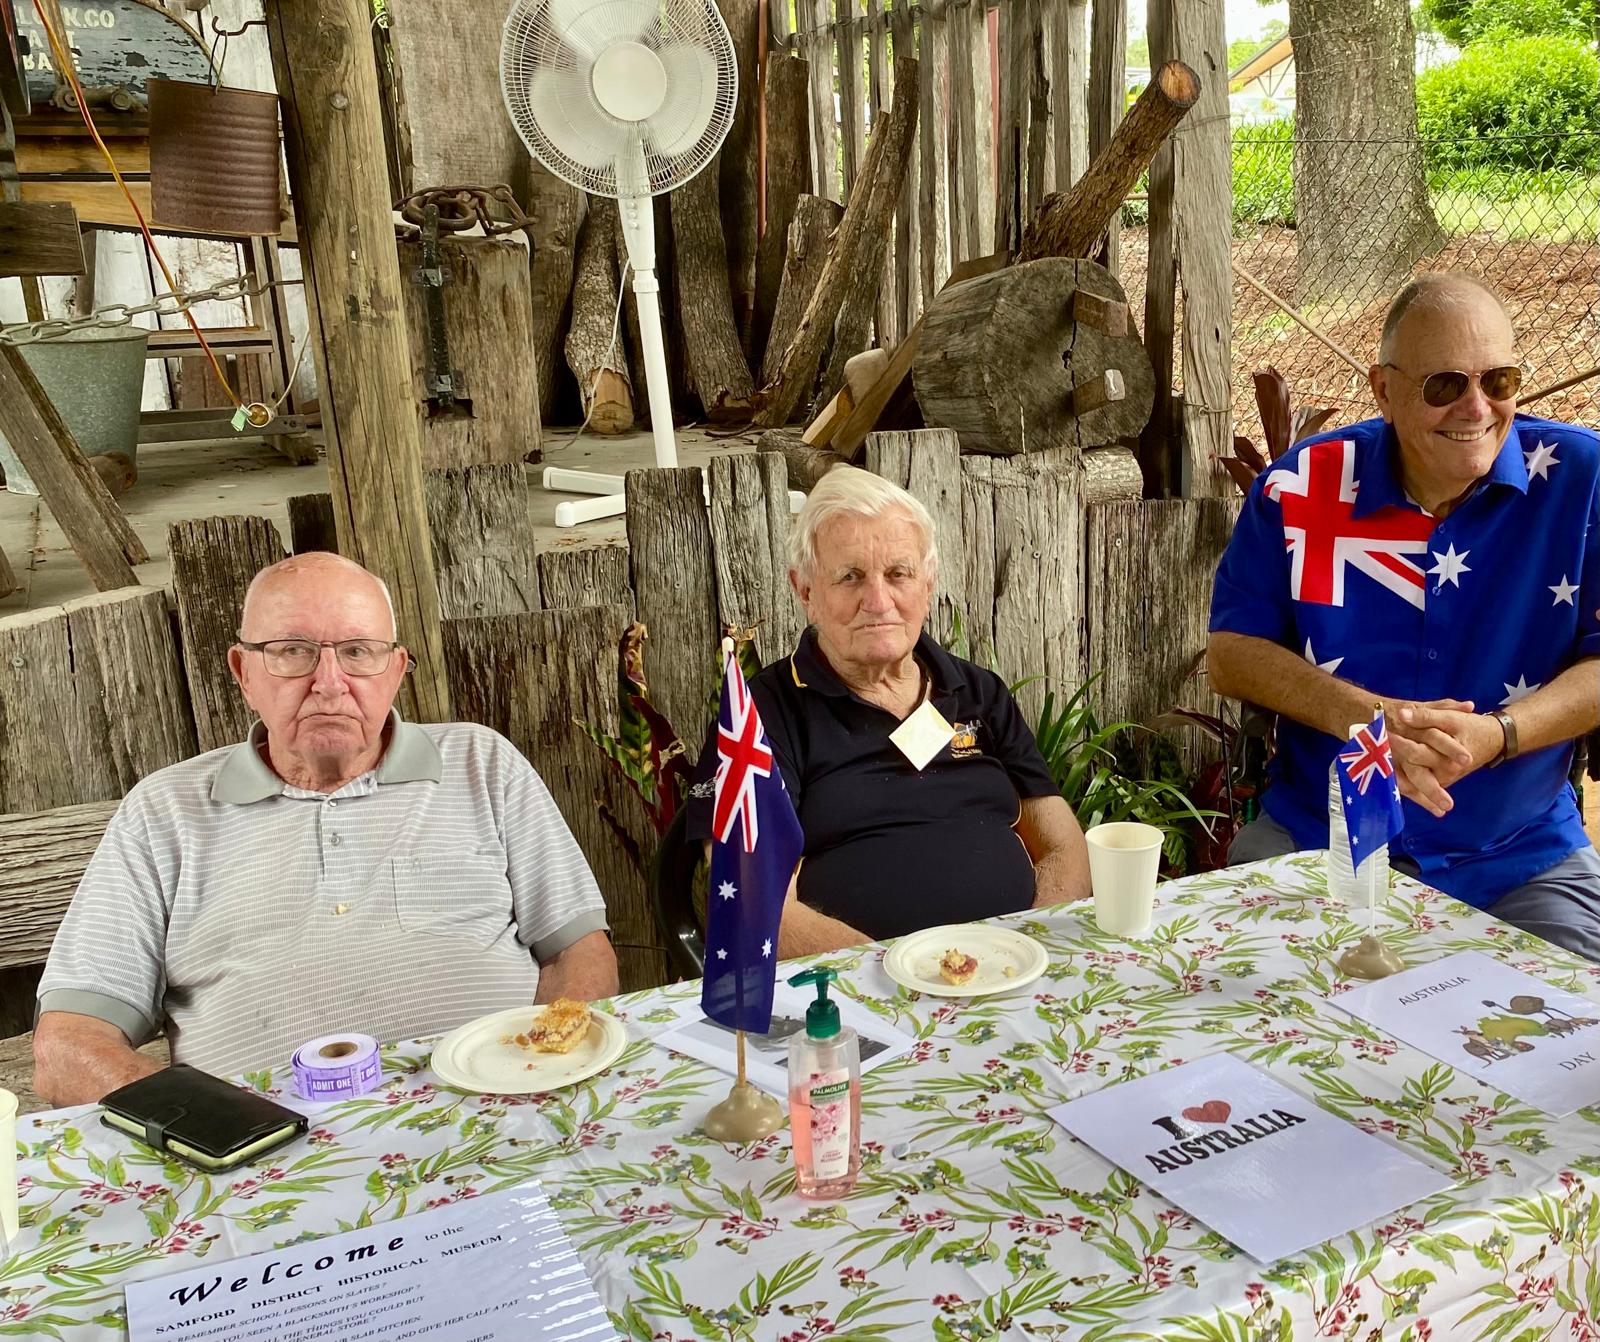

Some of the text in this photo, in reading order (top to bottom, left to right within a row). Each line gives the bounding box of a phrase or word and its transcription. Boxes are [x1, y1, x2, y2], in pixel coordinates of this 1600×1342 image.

[1398, 976, 1470, 1006] AUSTRALIA
[1558, 1051, 1597, 1072] DAY
[312, 1079, 335, 1091] ADMIT
[336, 1078, 352, 1089] ONE
[813, 1083, 847, 1095] PALMOLIVE
[1145, 1108, 1306, 1174] AUSTRALIA
[1151, 1115, 1197, 1141] I
[169, 1225, 464, 1306] Welcome to the
[155, 1234, 502, 1335] SAMFORD DISTRICT HISTORICAL MUSEUM
[177, 1323, 236, 1342] REMEMBER
[239, 1311, 281, 1327] SCHOOL
[284, 1299, 327, 1314] LESSONS
[329, 1294, 343, 1303] ON
[345, 1283, 380, 1298] SLATES
[247, 1324, 273, 1337] SEEN
[285, 1303, 358, 1327] BLACKSMITH'S
[360, 1286, 413, 1306] WORKSHOP
[283, 1329, 303, 1340] THE
[306, 1318, 342, 1334] THINGS
[346, 1312, 366, 1322] YOU
[369, 1302, 403, 1316] COULD
[406, 1295, 424, 1306] BUY
[338, 1318, 369, 1331] STORE
[396, 1330, 416, 1341] AND
[418, 1321, 441, 1334] GIVE
[444, 1315, 464, 1327] HER
[466, 1307, 490, 1320] CALF
[501, 1298, 519, 1309] PAT
[350, 1329, 375, 1341] SLAB
